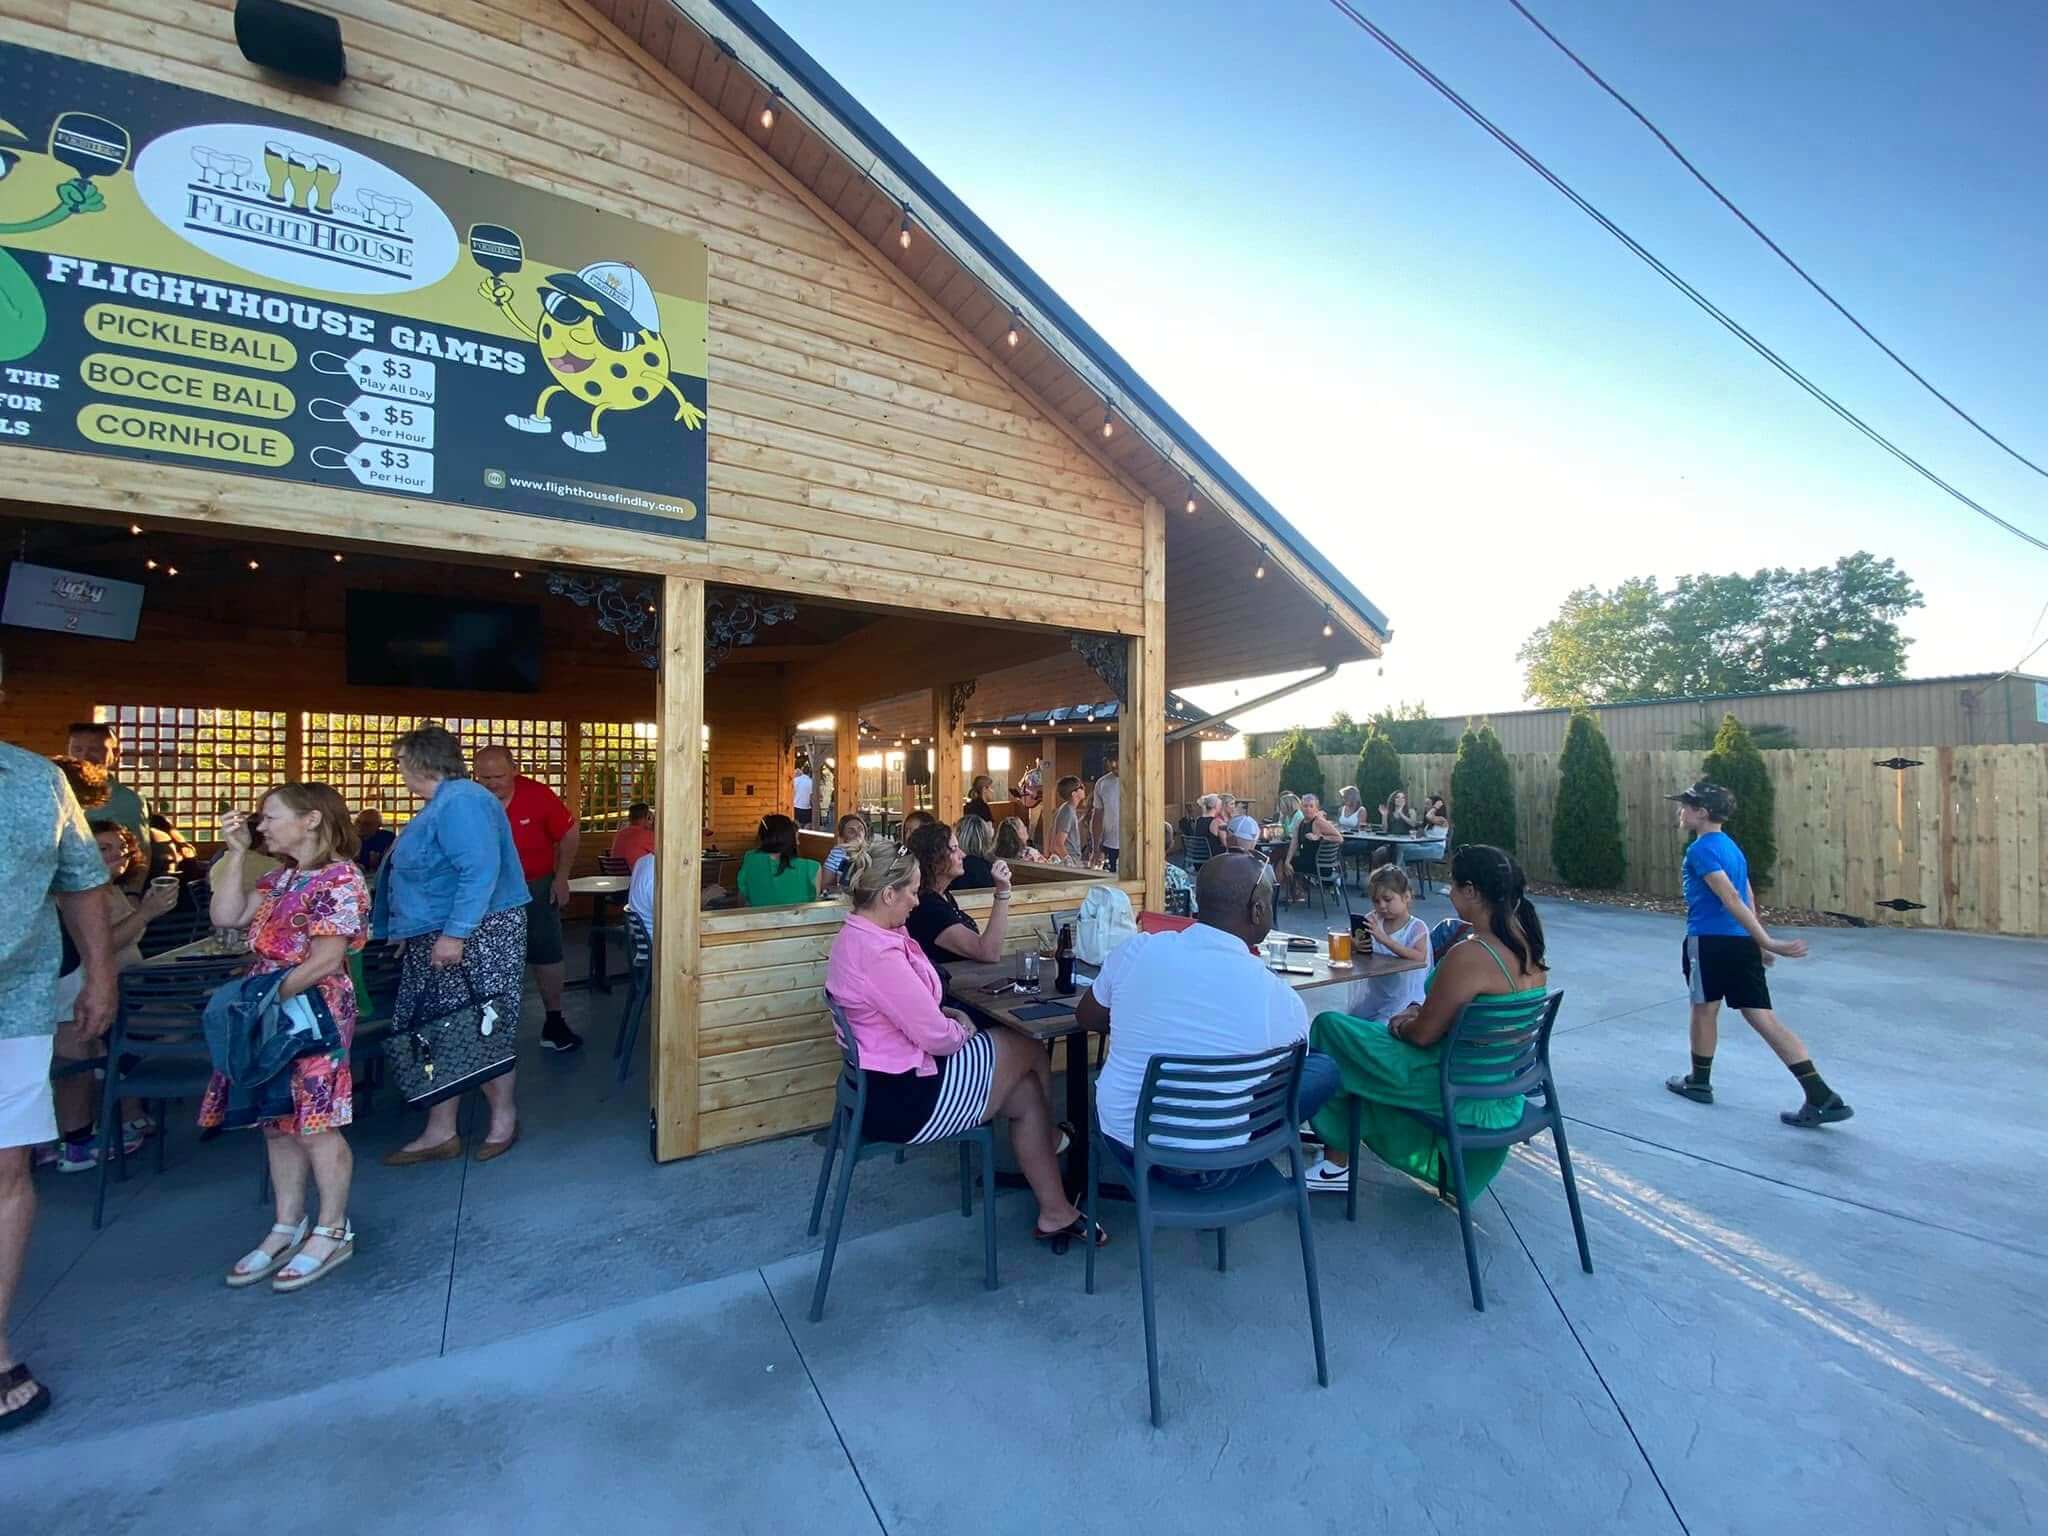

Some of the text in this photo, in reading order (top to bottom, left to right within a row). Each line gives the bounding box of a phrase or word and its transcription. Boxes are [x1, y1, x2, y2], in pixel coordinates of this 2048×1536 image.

[47, 255, 526, 375] FLIGHTHOUSE GAMES
[98, 312, 285, 363] PICKLEBALL
[5, 367, 60, 389] THE
[382, 358, 412, 379] $3
[88, 362, 289, 413] BOCCE BALL
[360, 377, 433, 400] Play All Day
[384, 405, 414, 427] $5
[96, 414, 277, 457] CORNHOLE
[370, 426, 426, 443] Per Hour
[380, 448, 410, 469] $3
[369, 470, 425, 487] Per Hour
[510, 477, 684, 514] www.flighthousefindlay.com
